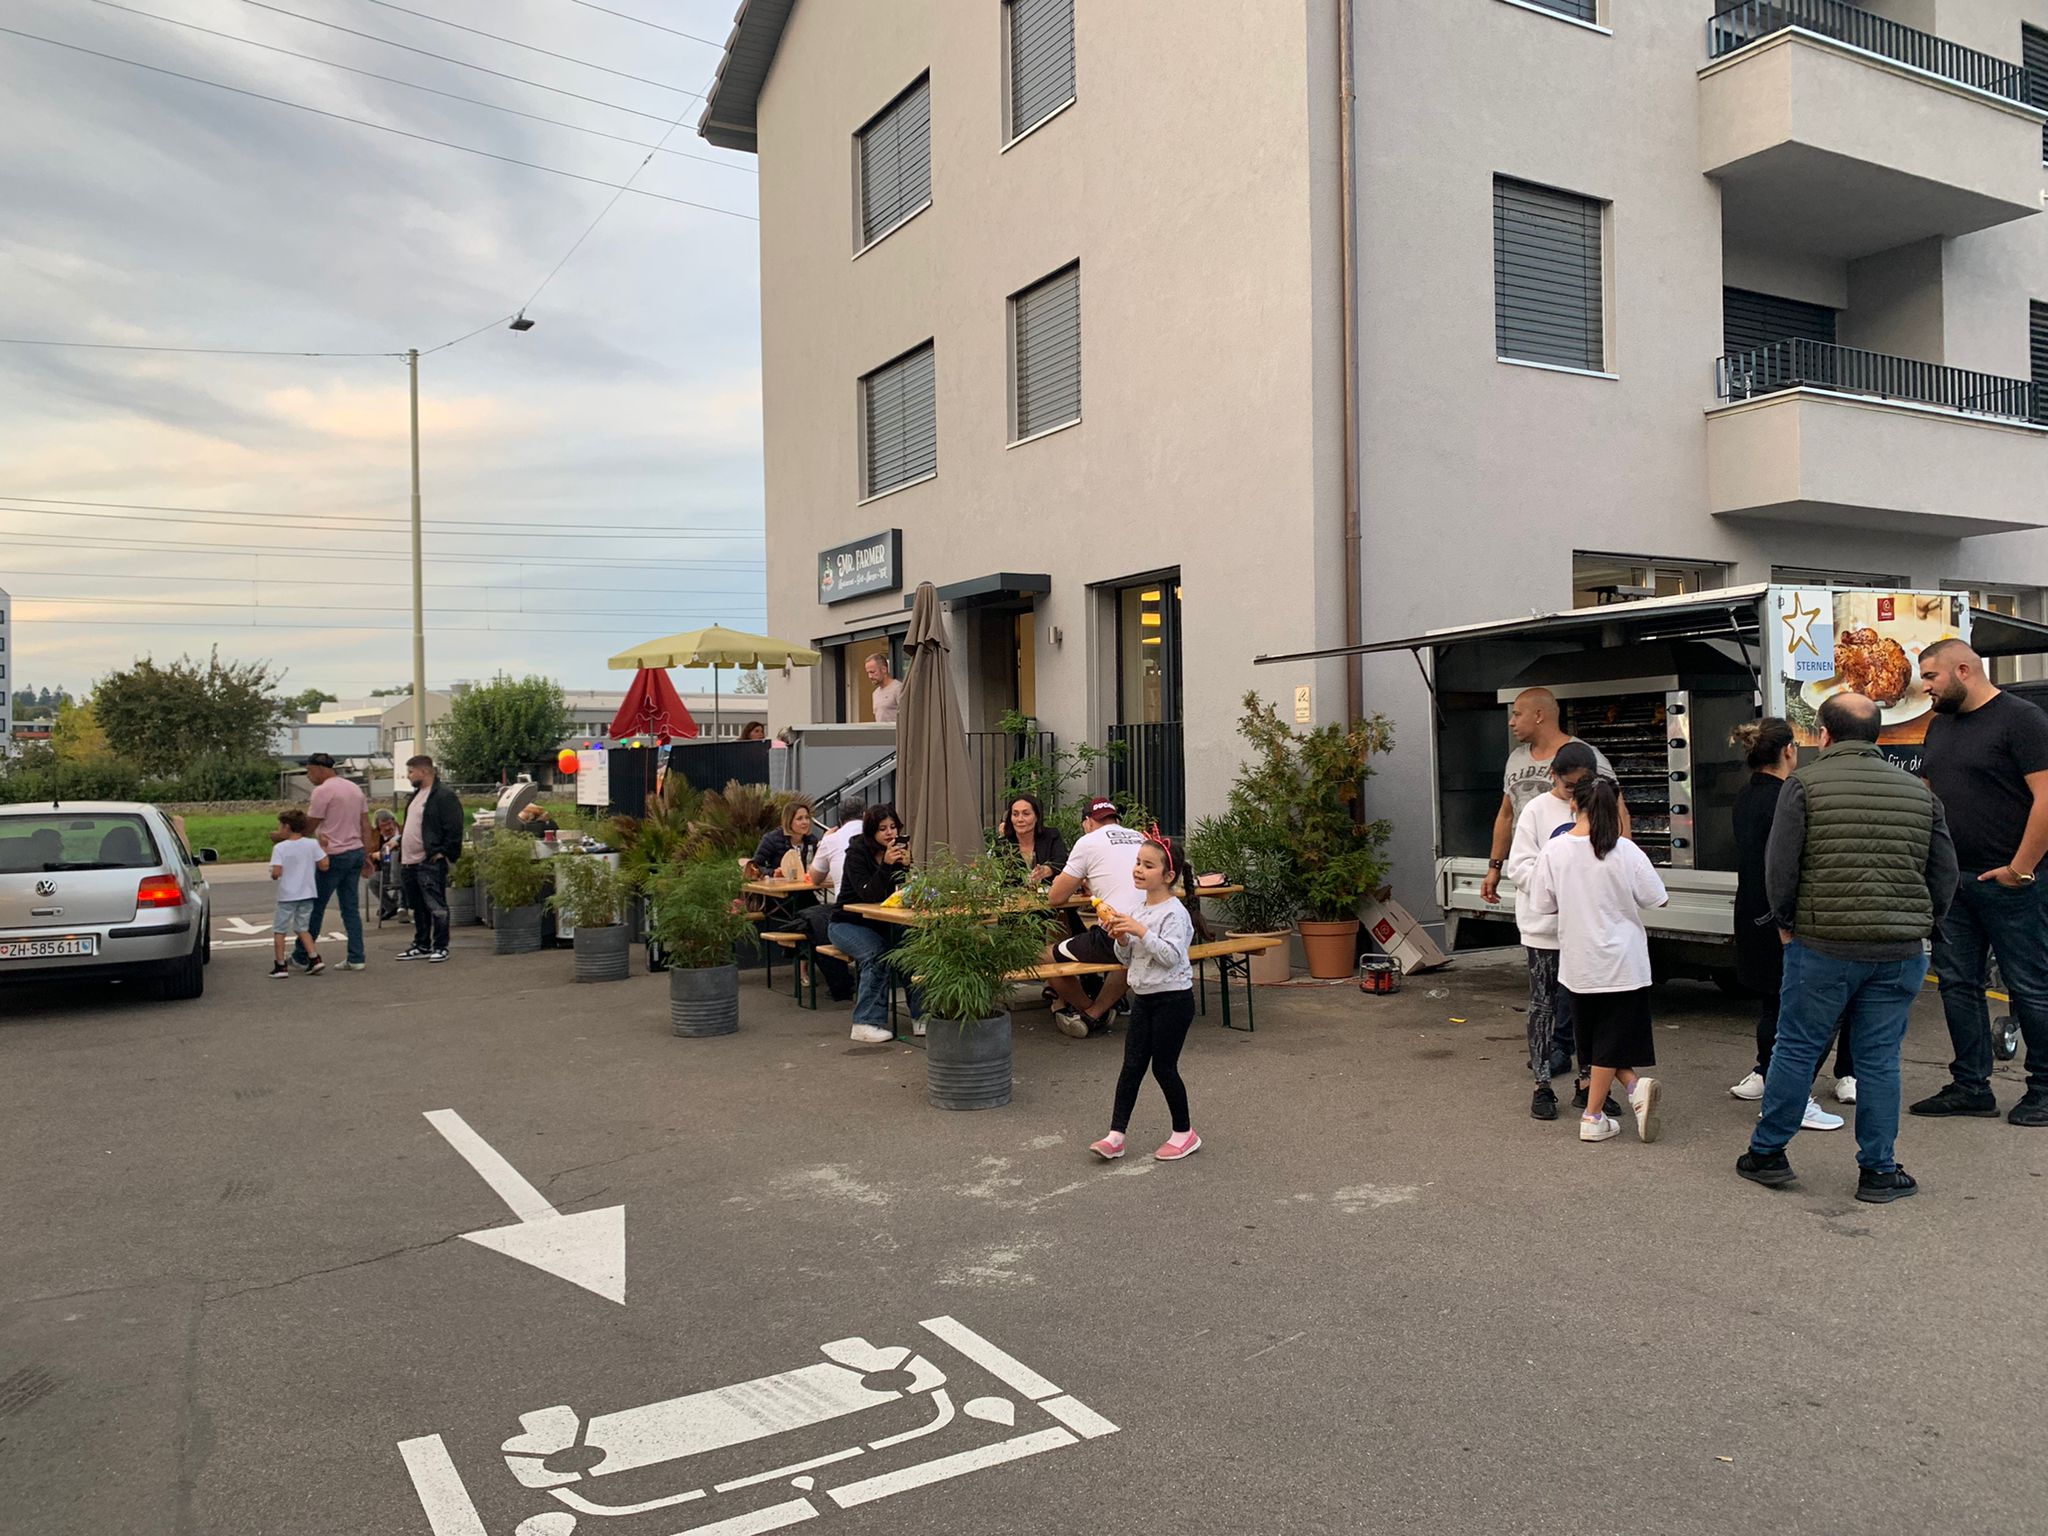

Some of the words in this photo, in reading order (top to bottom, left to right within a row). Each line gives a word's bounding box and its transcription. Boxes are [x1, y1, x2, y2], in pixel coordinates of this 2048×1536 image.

[856, 544, 885, 571] FARMER
[1796, 661, 1834, 671] STERNEN
[1888, 754, 1907, 769] für
